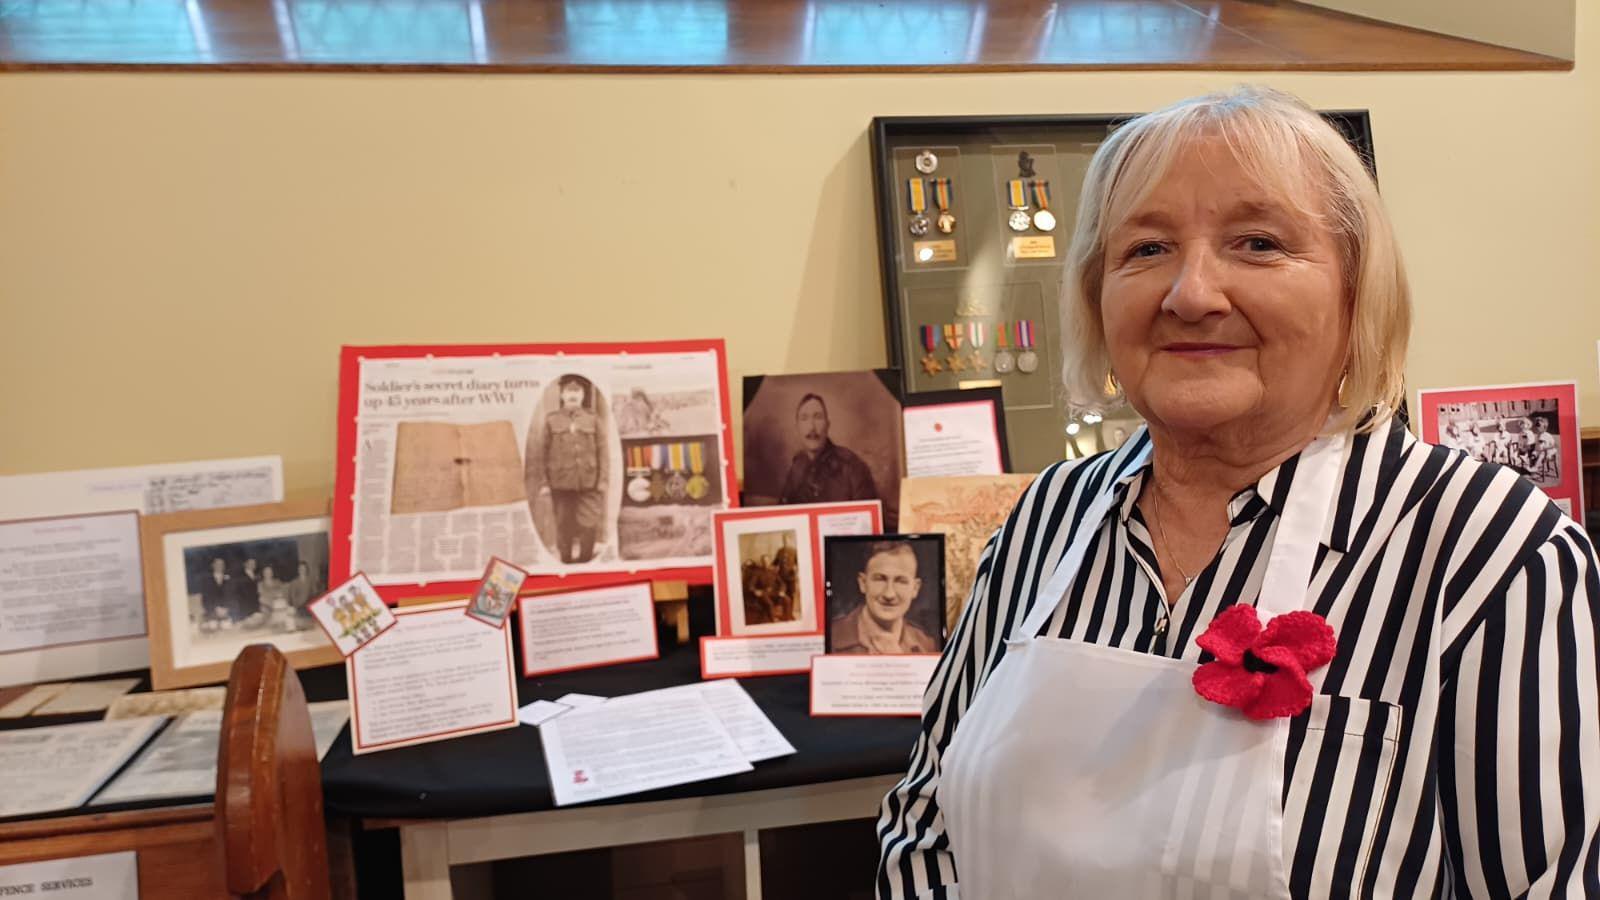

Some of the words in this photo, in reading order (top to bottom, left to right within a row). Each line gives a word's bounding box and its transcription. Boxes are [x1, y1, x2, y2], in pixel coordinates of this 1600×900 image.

[363, 379, 421, 393] Soldier's
[424, 381, 463, 391] secret
[466, 378, 501, 392] diary
[503, 379, 541, 390] turns
[363, 398, 383, 410] up
[404, 396, 441, 410] years
[441, 393, 474, 405] after
[478, 391, 517, 405] WWI
[41, 878, 93, 891] SERVICES
